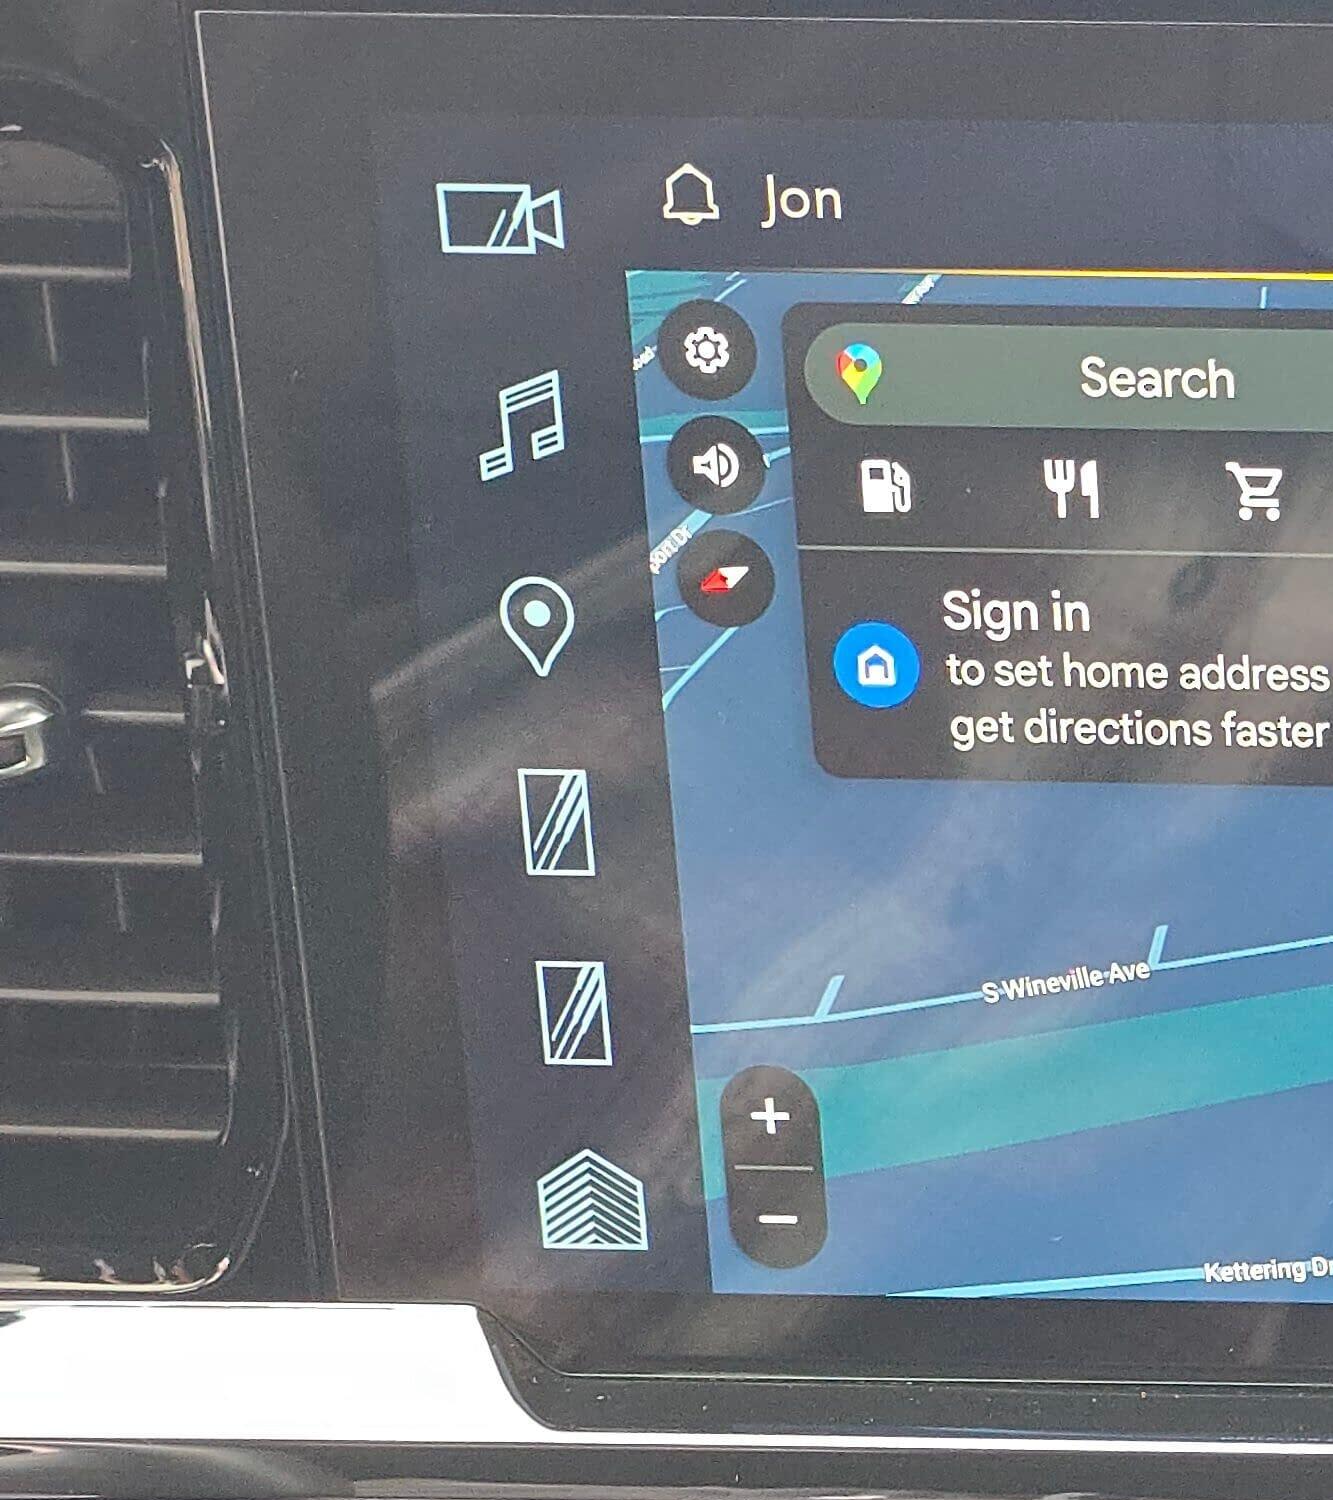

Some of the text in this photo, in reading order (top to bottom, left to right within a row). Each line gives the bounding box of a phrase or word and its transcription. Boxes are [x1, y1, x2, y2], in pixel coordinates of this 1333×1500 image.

[761, 173, 842, 229] Jon
[1080, 355, 1236, 399] Search
[942, 587, 1091, 641] Sign in
[946, 653, 986, 687] to
[994, 655, 1054, 688] set
[1063, 651, 1169, 690] home
[1178, 653, 1331, 693] address
[950, 707, 1331, 752] get directions faster
[981, 961, 1151, 1004] S Wineville Ave
[1203, 1258, 1307, 1284] Kettering
